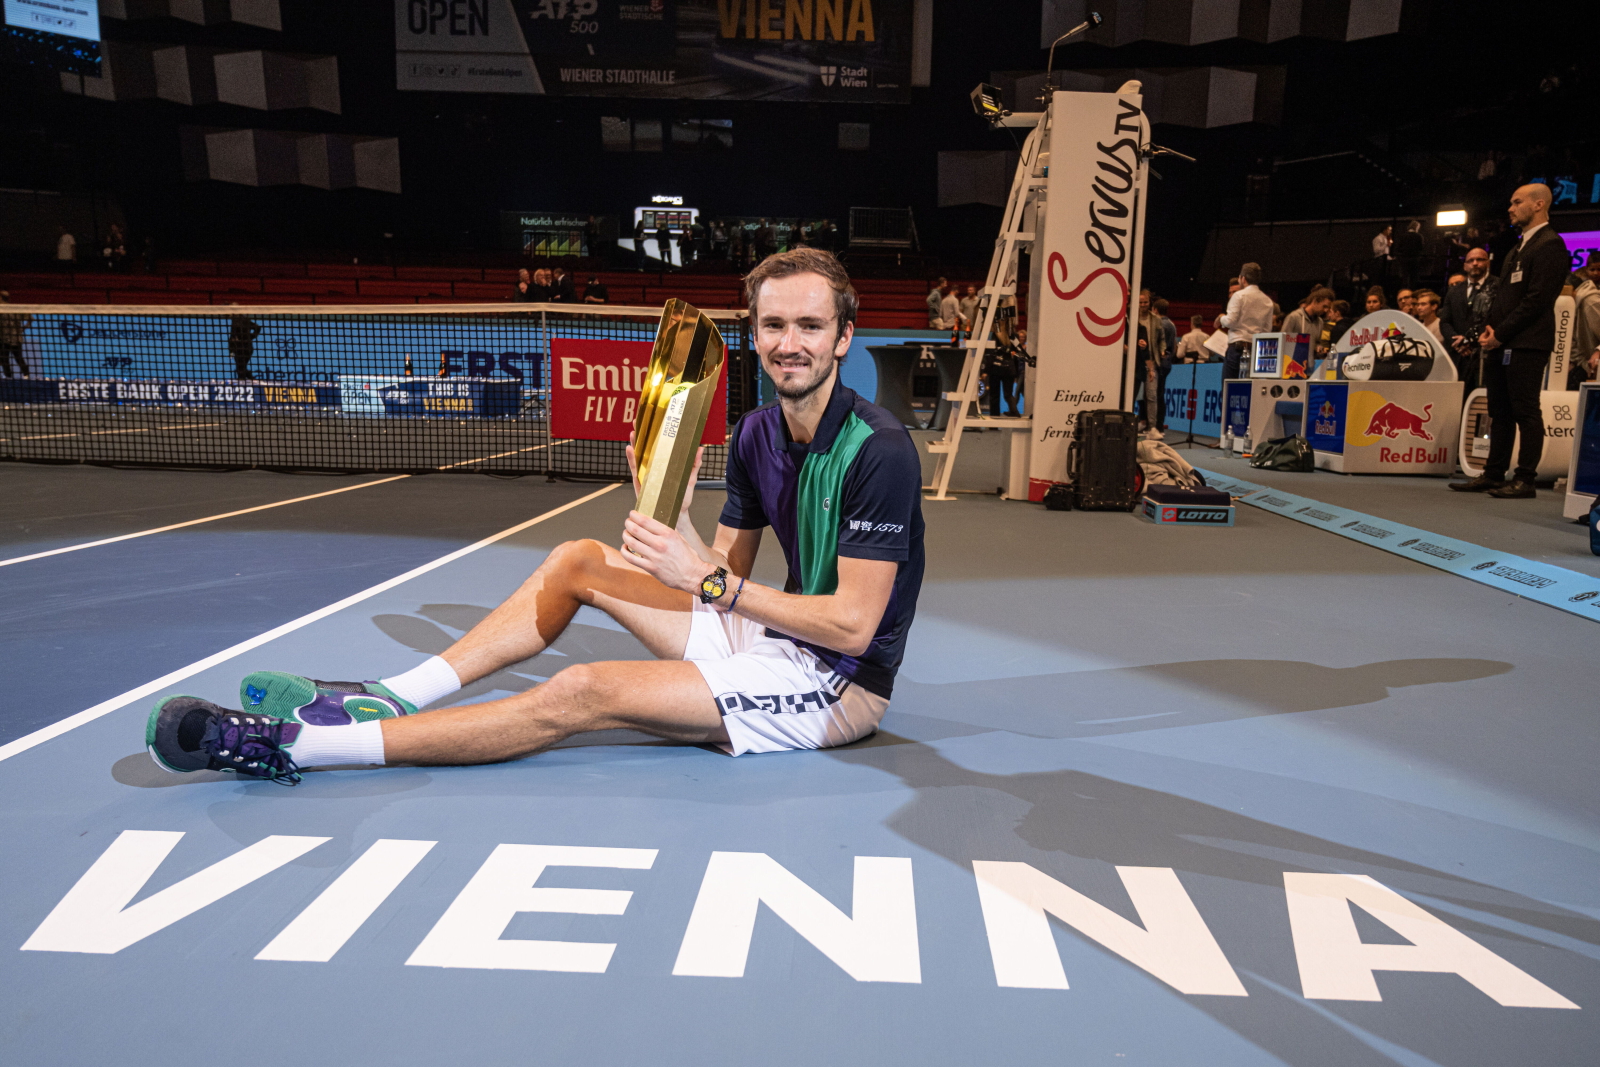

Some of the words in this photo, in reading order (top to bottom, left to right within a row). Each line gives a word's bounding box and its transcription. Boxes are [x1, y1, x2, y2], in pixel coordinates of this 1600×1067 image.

[407, 0, 489, 36] OPEN
[530, 0, 599, 20] ATP
[569, 21, 599, 34] 500
[717, 0, 876, 42] VIENNA
[560, 67, 603, 83] WIENER
[605, 68, 676, 85] STADTHALLE
[840, 66, 868, 77] Stadt
[840, 77, 868, 88] Wien
[1553, 310, 1571, 374] waterdrop
[441, 350, 550, 389] ERST
[560, 357, 649, 392] Emir
[58, 382, 110, 400] ERSTE
[116, 383, 163, 401] BANK
[167, 384, 209, 401] OPEN
[214, 386, 255, 402] 2022
[263, 387, 318, 403] VIENNA
[428, 383, 454, 397] THIS
[457, 383, 470, 397] IS
[1053, 389, 1105, 407] Einfach
[584, 396, 617, 423] FLY
[1163, 387, 1187, 419] RSTE
[1380, 446, 1413, 463] Red
[1415, 447, 1448, 464] Bull
[1178, 511, 1227, 521] LOTTO
[20, 829, 1582, 1010] VIENNA
